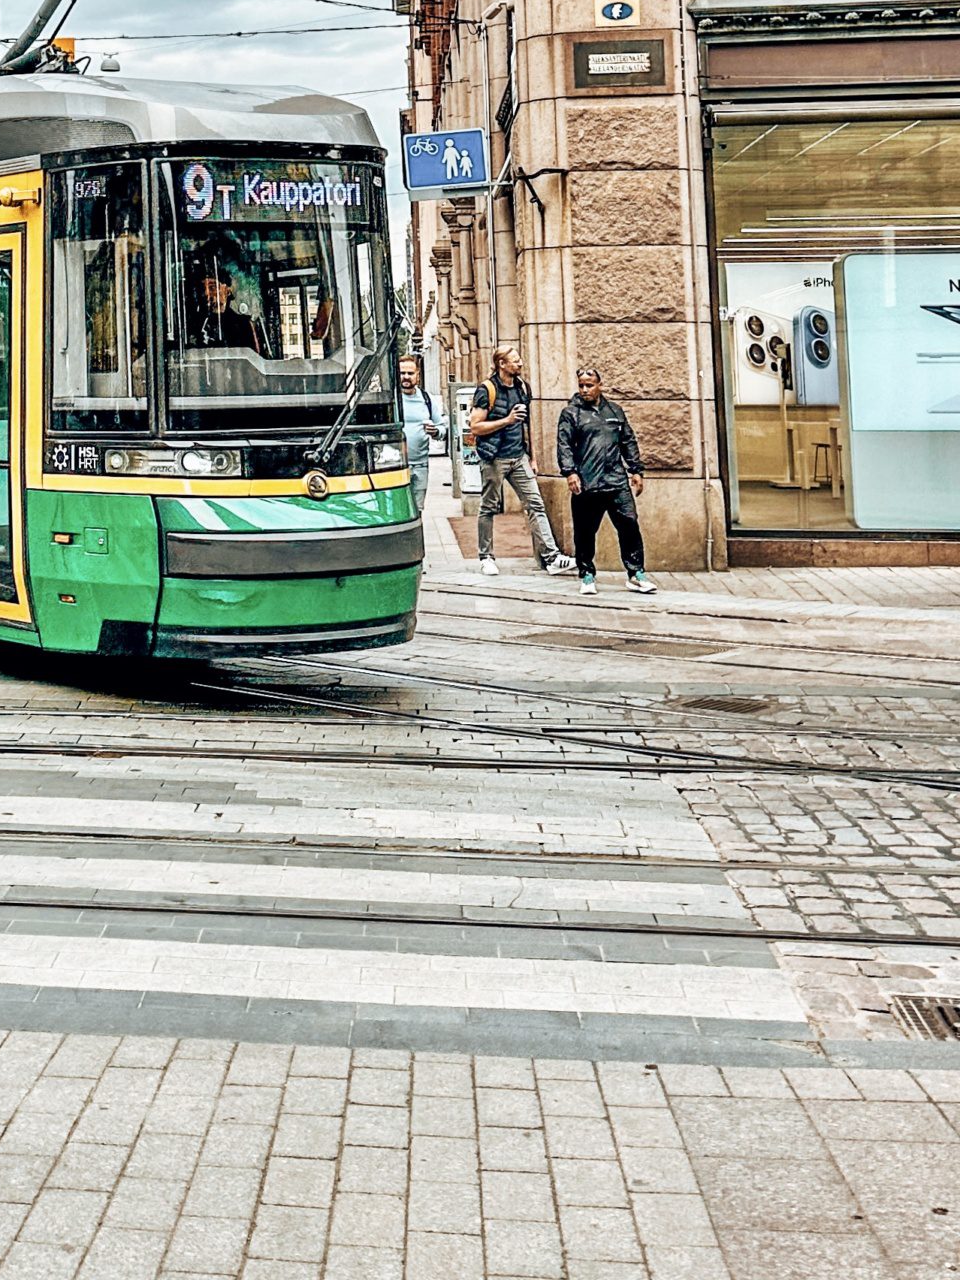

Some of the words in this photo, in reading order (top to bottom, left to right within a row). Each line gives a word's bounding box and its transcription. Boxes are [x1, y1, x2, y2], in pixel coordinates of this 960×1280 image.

[243, 173, 361, 211] Kauppatori
[812, 277, 835, 288] iPh
[78, 446, 99, 458] HSL
[78, 458, 99, 470] HRT
